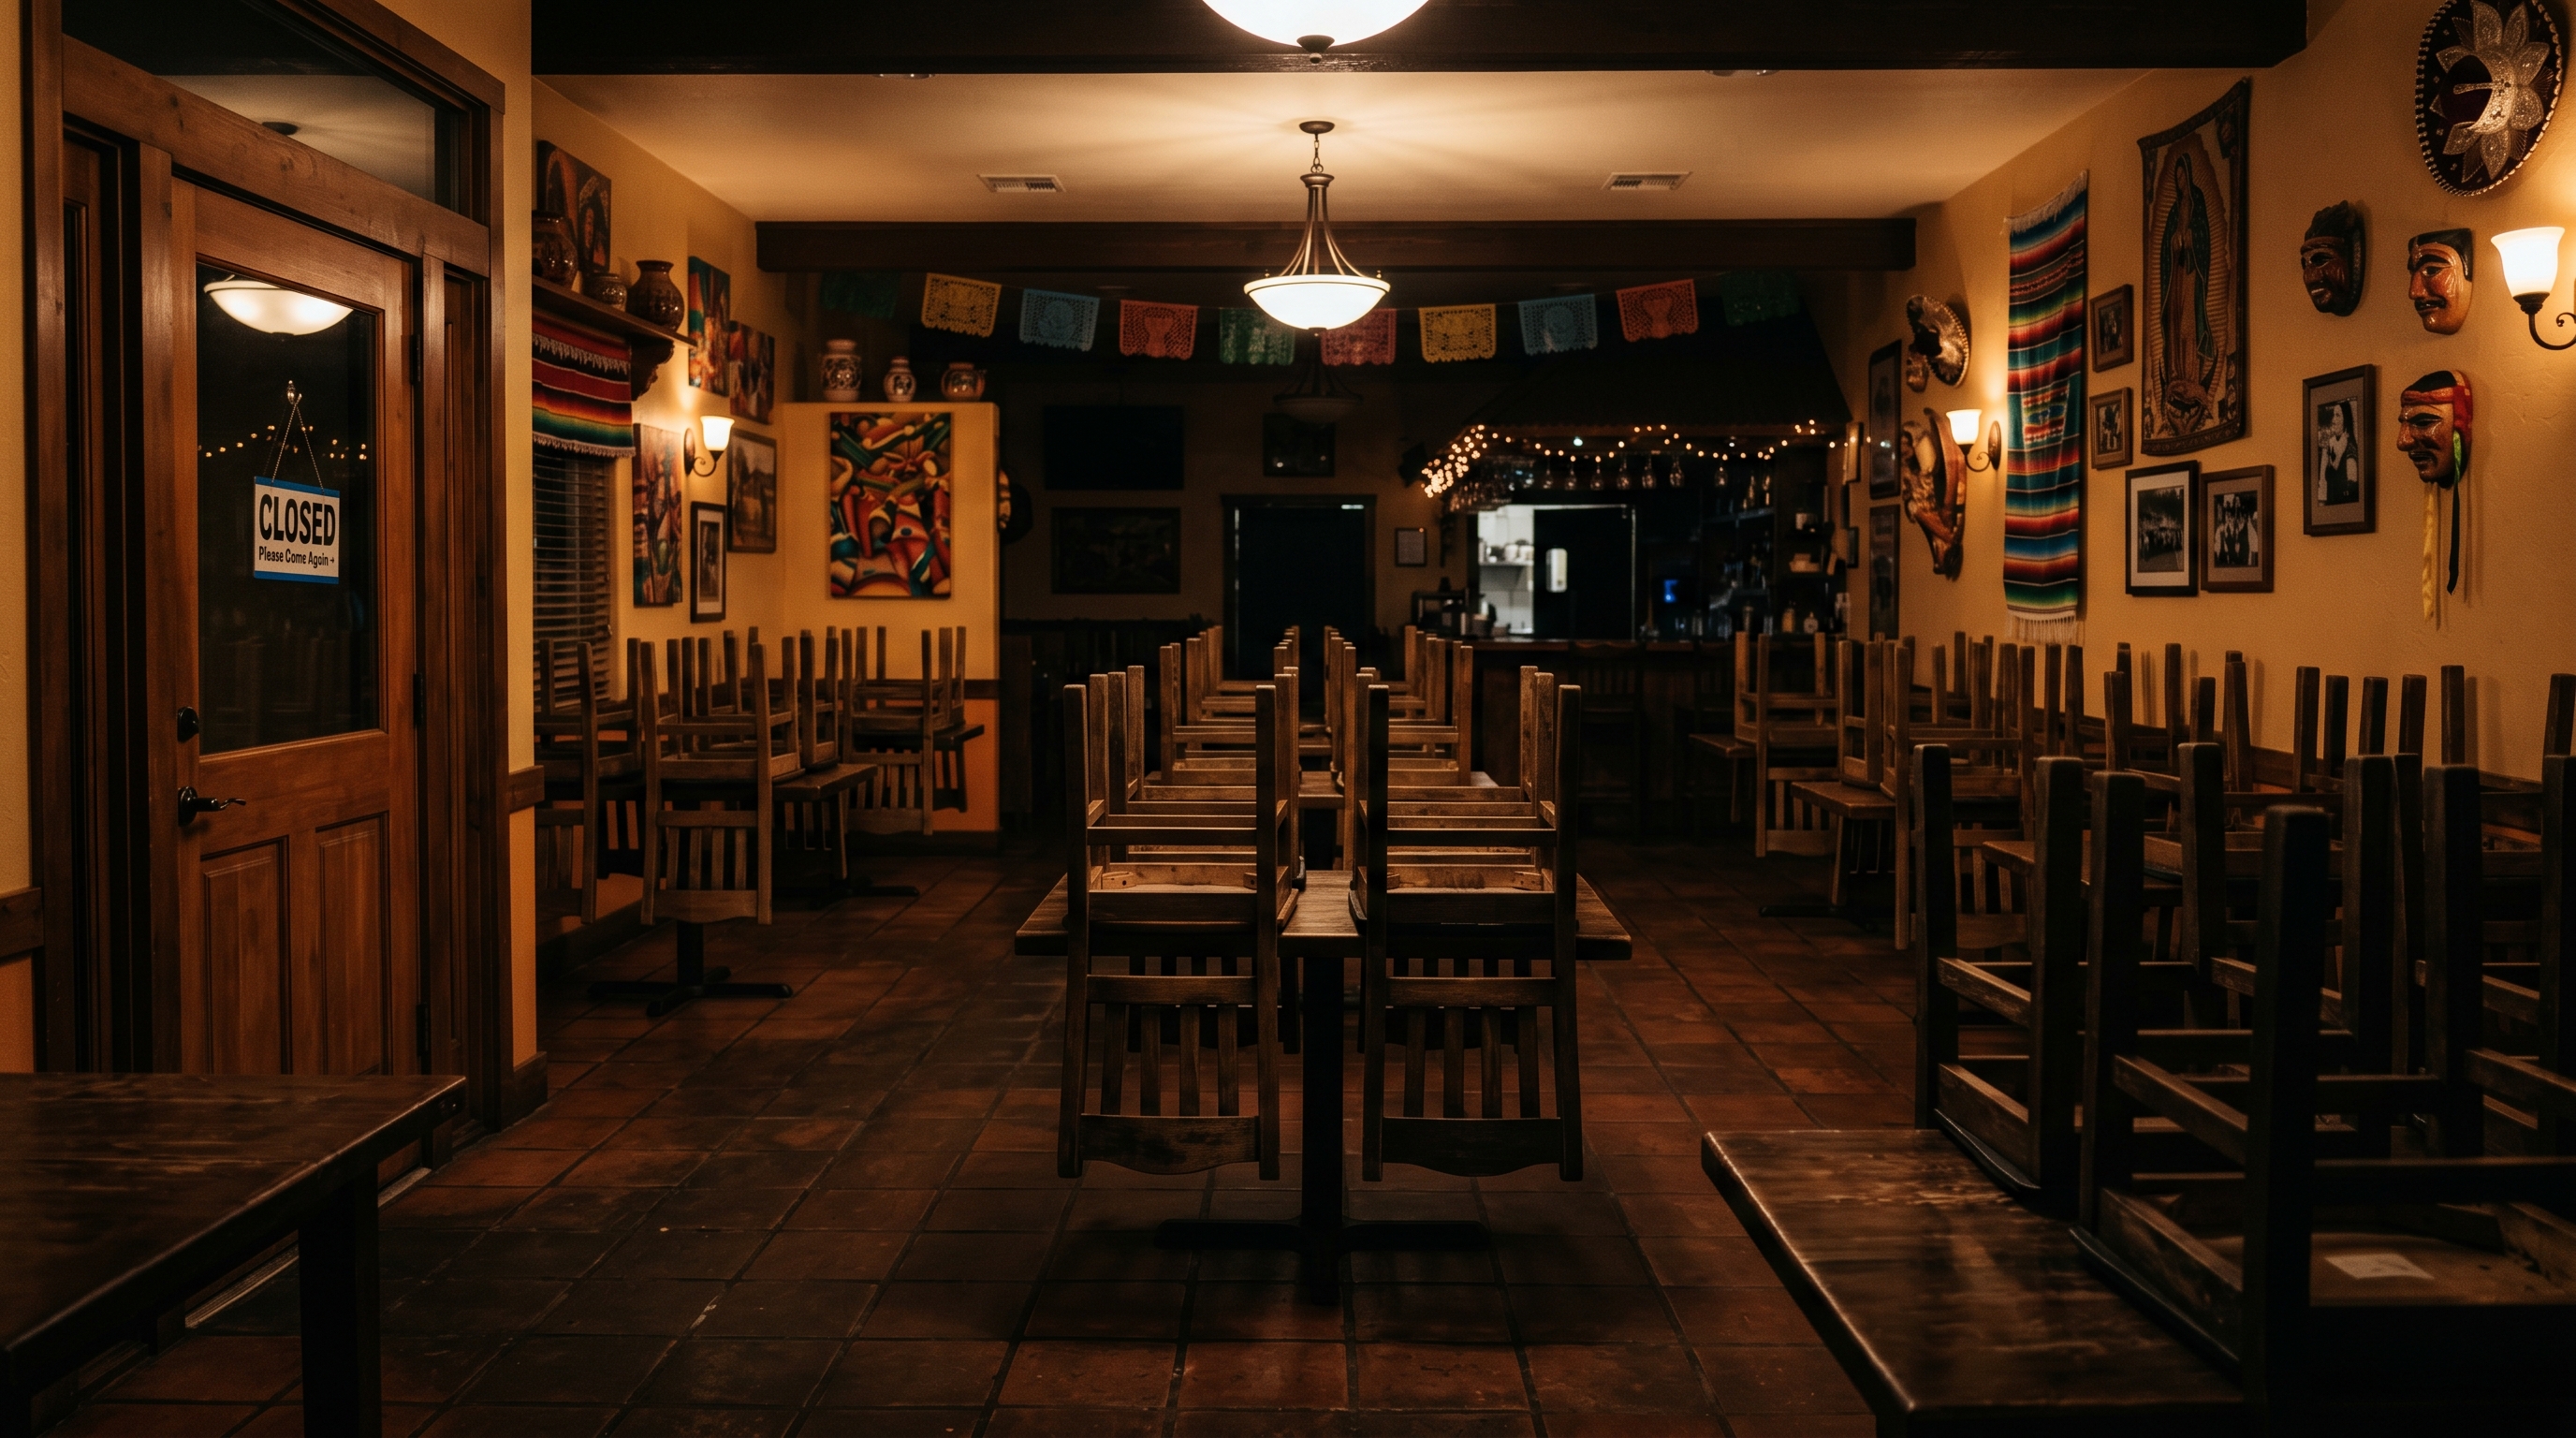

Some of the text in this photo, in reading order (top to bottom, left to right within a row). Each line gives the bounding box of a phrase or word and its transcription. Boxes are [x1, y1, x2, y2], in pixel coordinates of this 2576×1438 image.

[259, 493, 336, 546] CLOSED
[258, 546, 329, 568] Please Come Again
